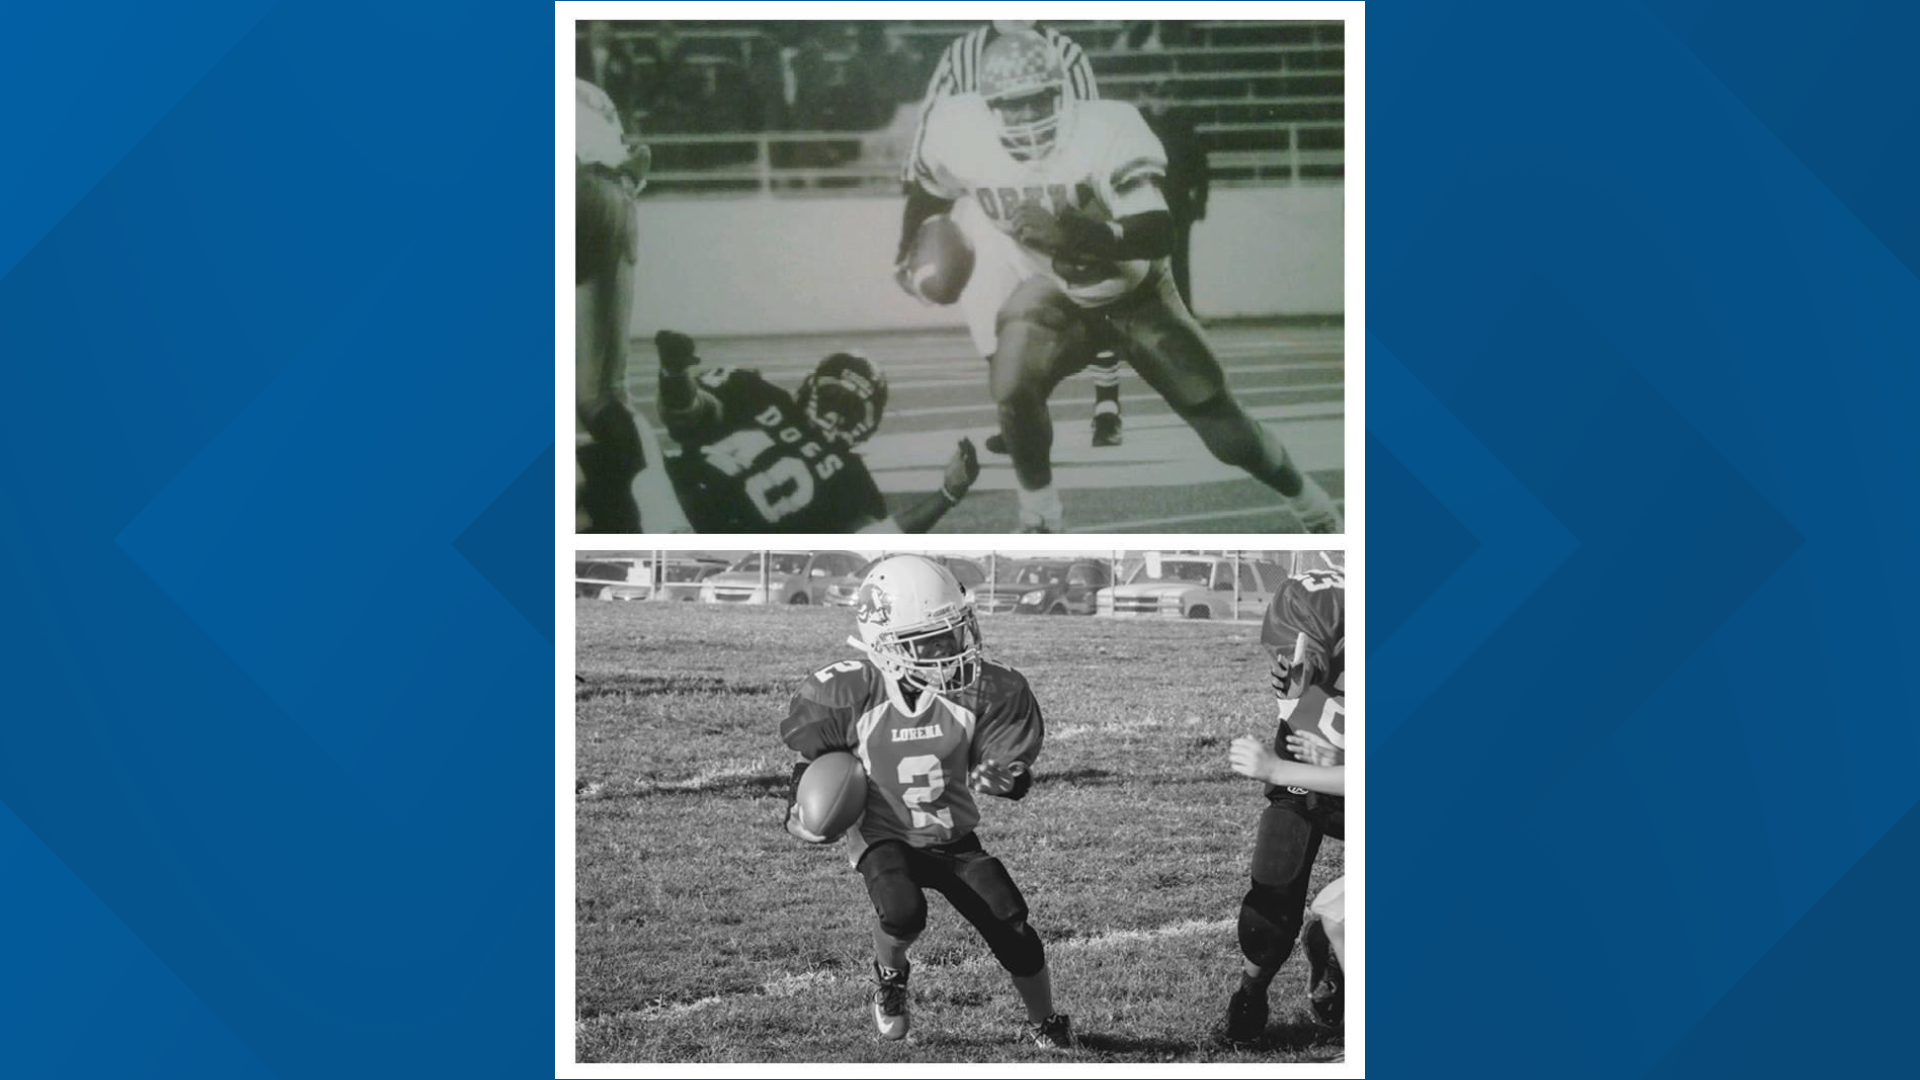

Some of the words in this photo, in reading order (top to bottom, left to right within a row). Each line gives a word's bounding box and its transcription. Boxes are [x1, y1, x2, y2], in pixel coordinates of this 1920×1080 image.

[754, 405, 844, 480] DOGS
[891, 724, 944, 742] LORENA
[897, 754, 954, 828] 2
